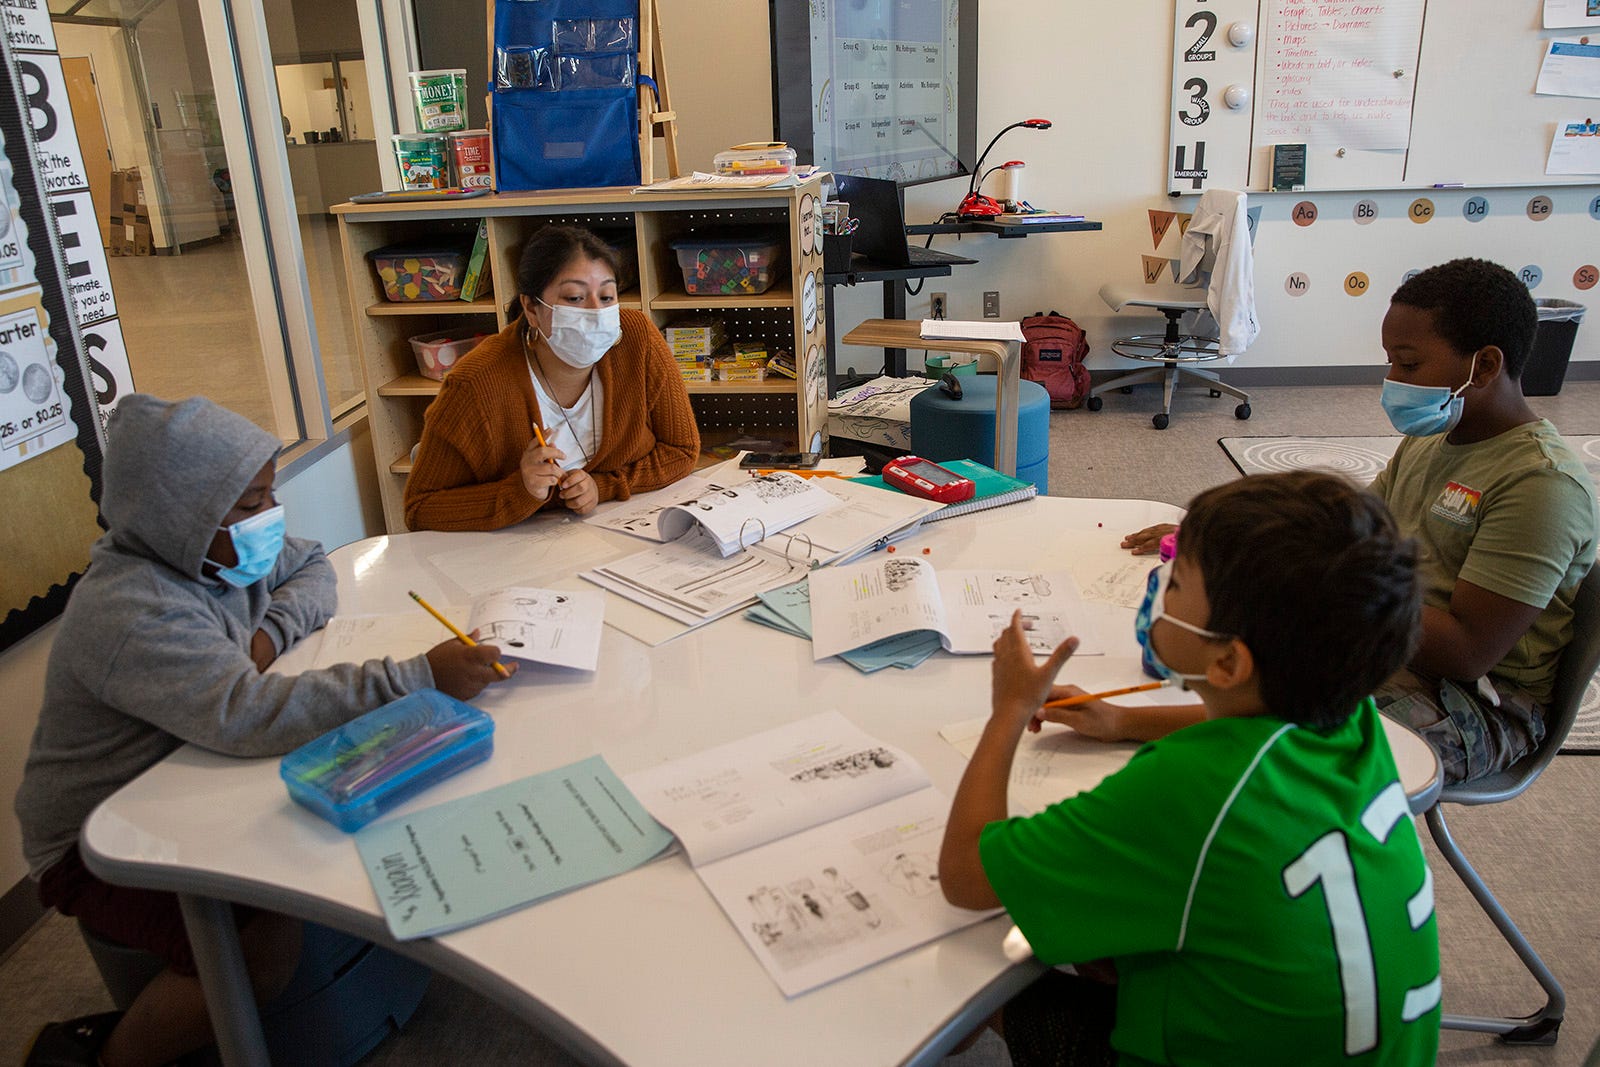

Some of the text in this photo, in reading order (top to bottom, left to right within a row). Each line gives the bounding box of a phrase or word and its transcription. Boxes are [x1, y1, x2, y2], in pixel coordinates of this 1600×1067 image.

[8, 30, 45, 44] estion.
[1185, 11, 1217, 62] 2
[1283, 35, 1306, 47] Maps
[1191, 36, 1208, 53] SMALL
[421, 83, 454, 99] MONEY
[1178, 77, 1210, 126] 3
[1192, 97, 1209, 114] WHOLE
[1184, 117, 1204, 125] GROUP
[464, 146, 480, 156] TIME
[52, 152, 71, 168] the
[1174, 141, 1208, 189] 4
[45, 173, 84, 188] words.
[1175, 170, 1208, 178] EMERGENCY
[1296, 207, 1314, 219] Aa
[1357, 204, 1375, 218] Bb
[1414, 204, 1431, 216] Cc
[1467, 201, 1486, 215] Dd
[1531, 200, 1548, 214] Ee
[0, 242, 18, 258] .05
[1348, 276, 1366, 289] Oo
[1521, 269, 1538, 282] Rr
[1578, 269, 1595, 283] Ss
[1289, 276, 1306, 290] Nn
[81, 291, 111, 310] you do
[83, 333, 117, 405] S
[22, 418, 33, 430] or
[36, 402, 63, 424] $0.25
